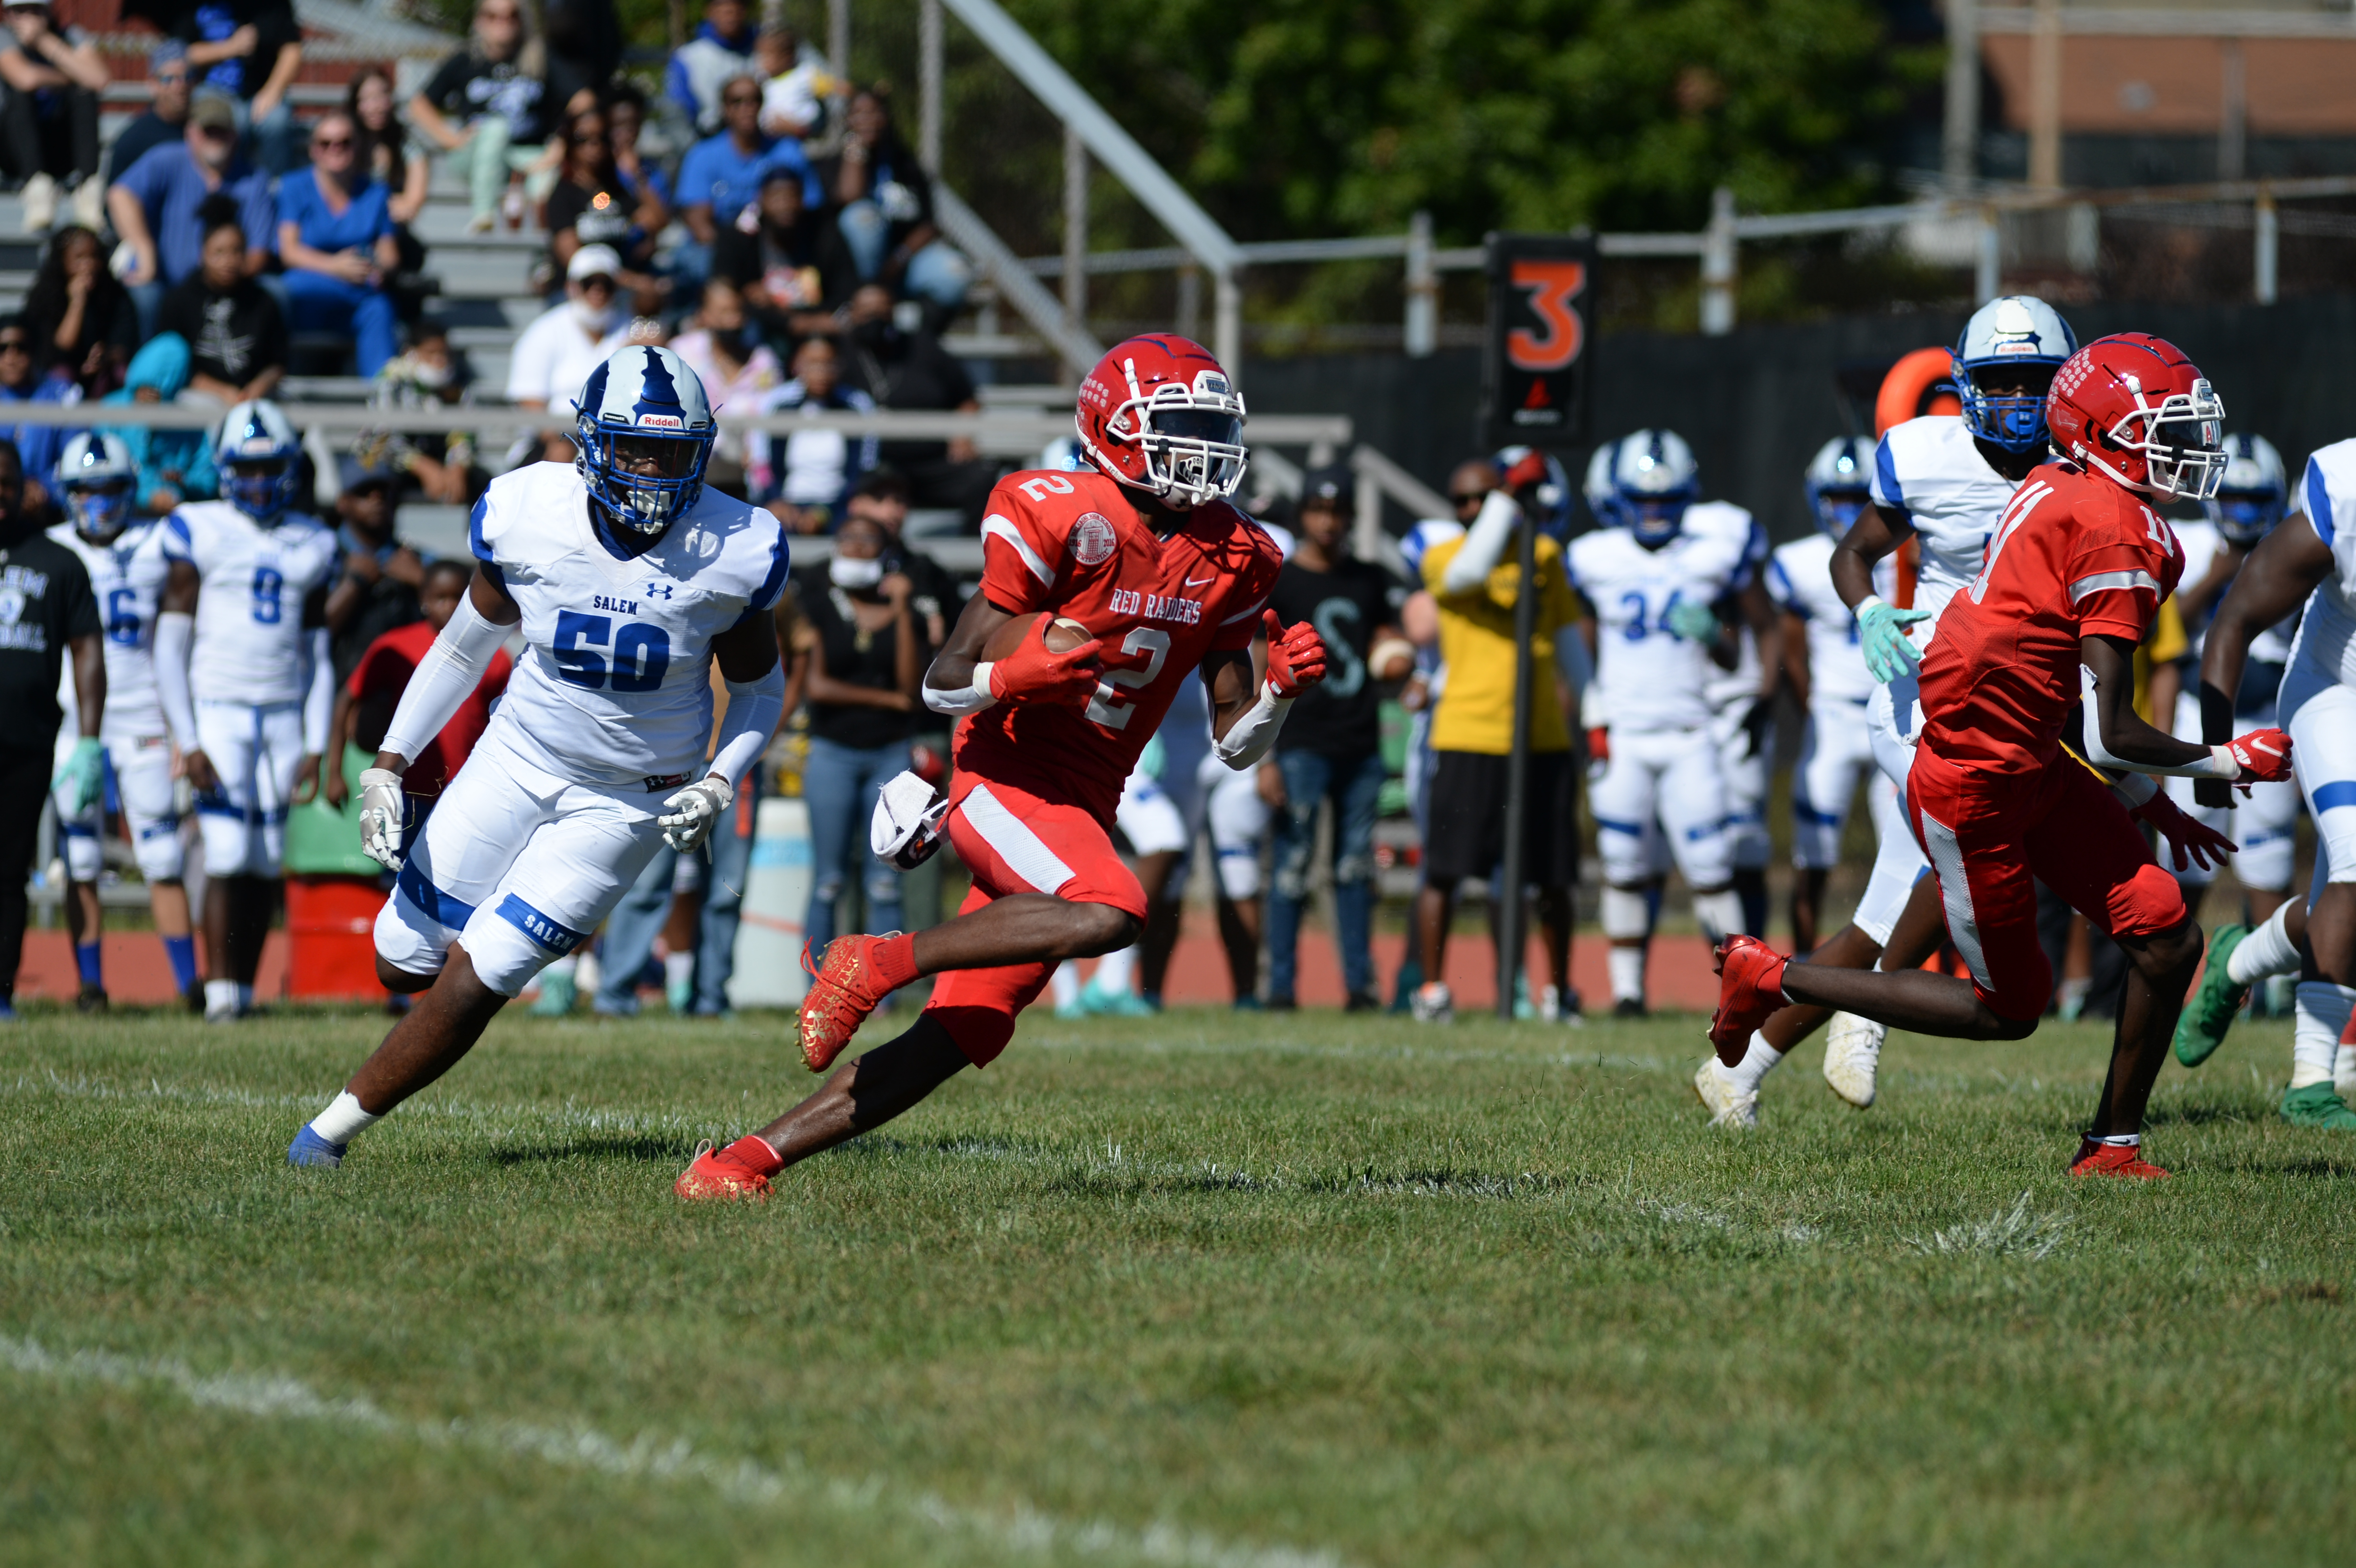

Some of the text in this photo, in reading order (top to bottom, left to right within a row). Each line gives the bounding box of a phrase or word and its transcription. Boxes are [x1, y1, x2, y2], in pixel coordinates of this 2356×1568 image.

[1507, 261, 1584, 370] 3
[645, 417, 679, 426] Riddell
[1018, 476, 1074, 502] 2
[1103, 538, 1115, 547] 2016
[253, 566, 283, 623] 9
[593, 595, 638, 615] SALEM
[1109, 588, 1202, 624] RED RAIDERS
[553, 609, 670, 692] 50
[1084, 626, 1171, 731] 2
[524, 914, 574, 949] SALEM
